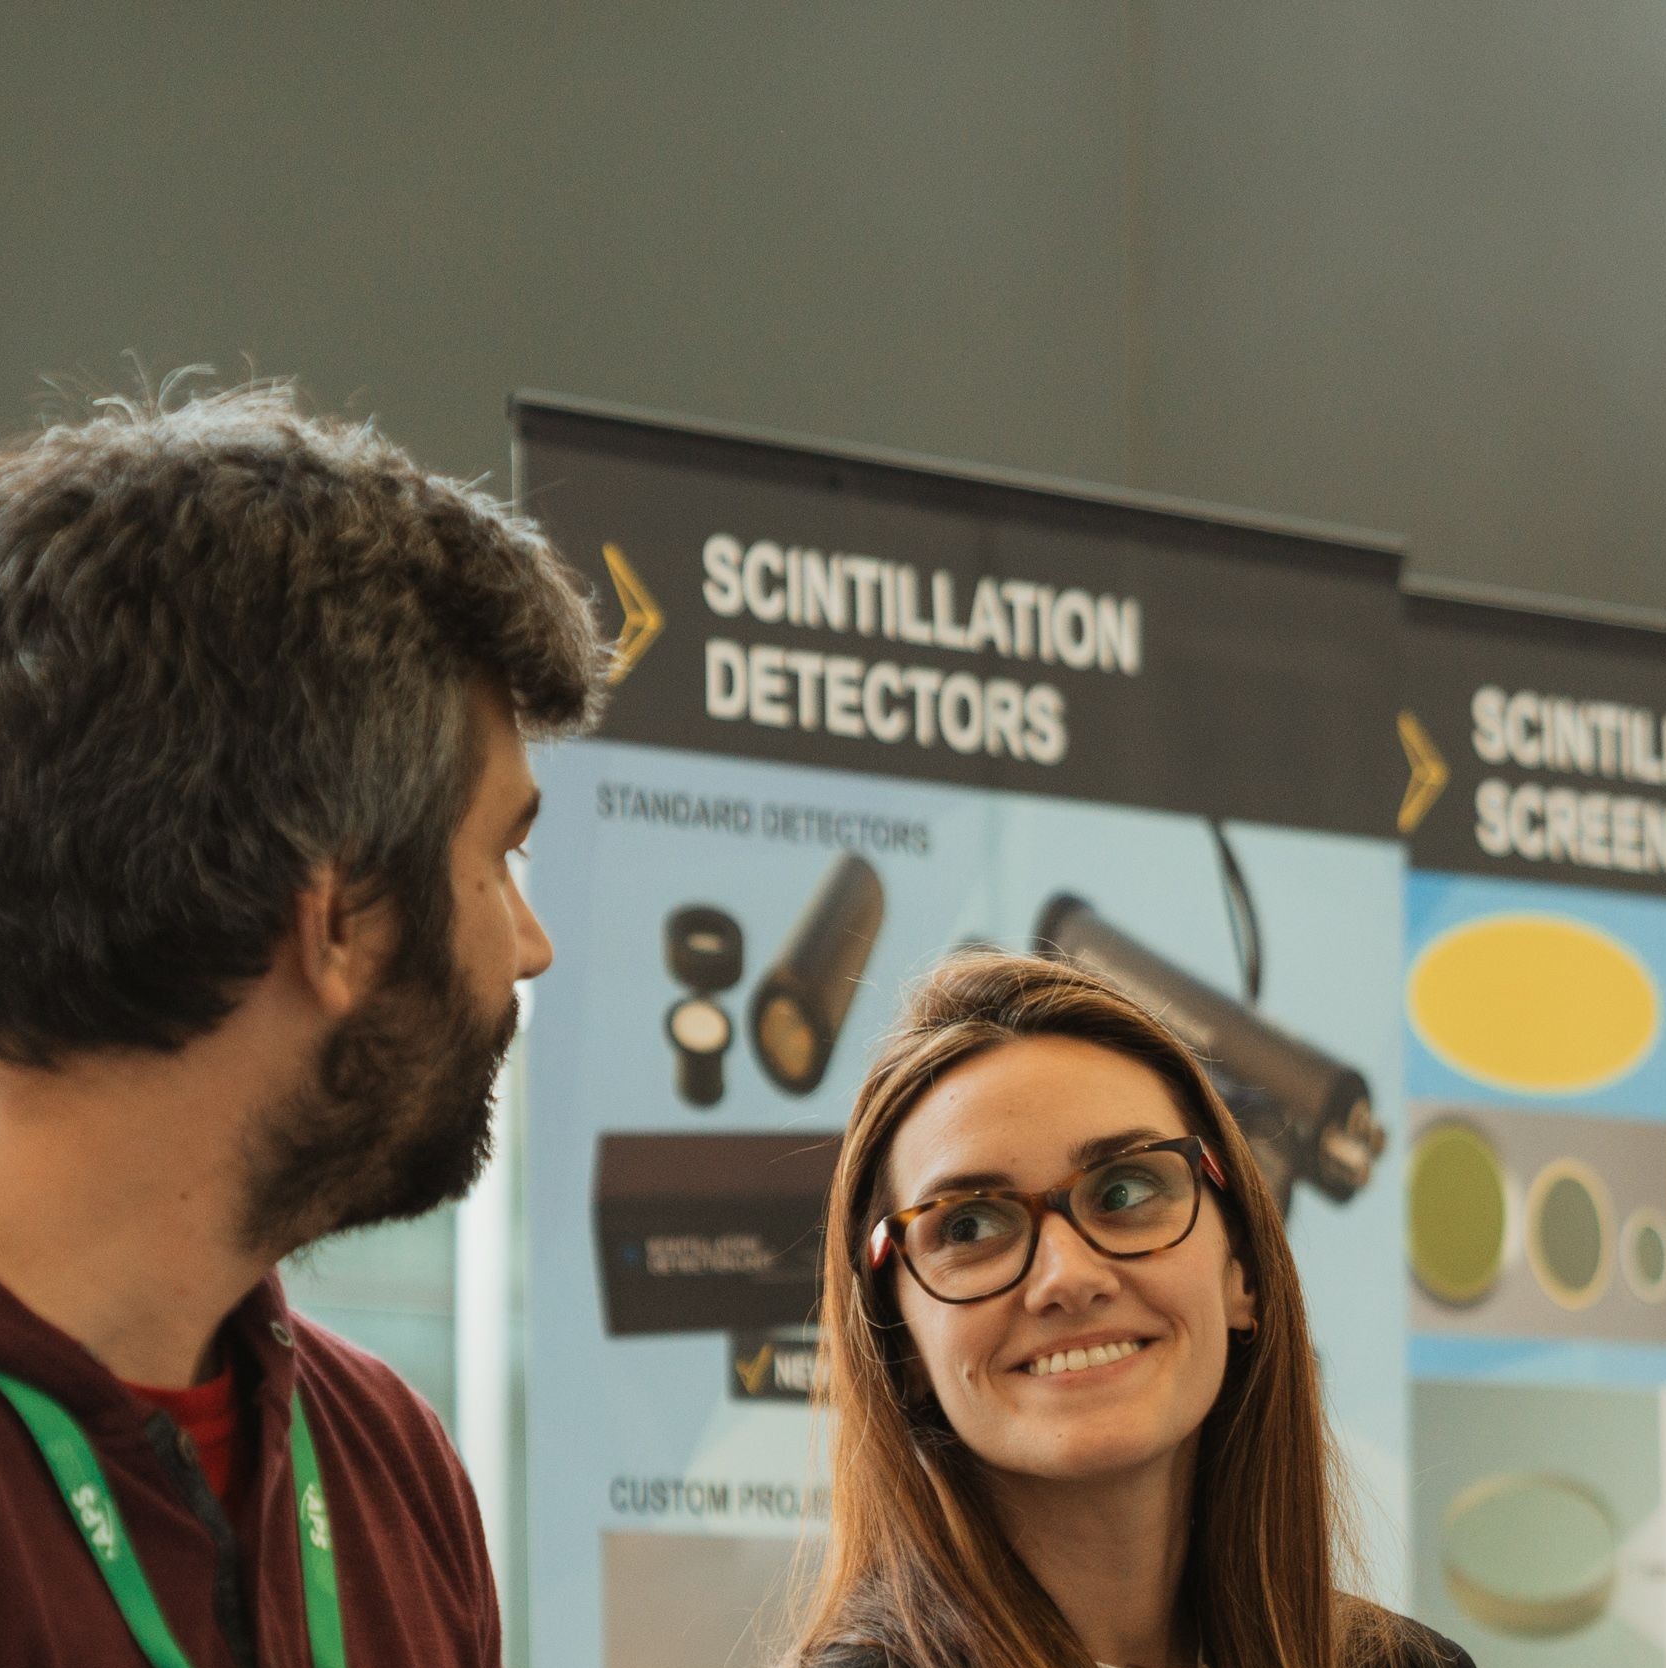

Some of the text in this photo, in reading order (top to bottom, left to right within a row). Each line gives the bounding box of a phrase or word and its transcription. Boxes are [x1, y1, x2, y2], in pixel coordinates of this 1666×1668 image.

[703, 534, 1142, 677] SCINTILLATION
[705, 640, 1069, 766] DETECTORS
[596, 783, 931, 858] STANDARD DETECTORS
[610, 1476, 728, 1516] CUSTOM
